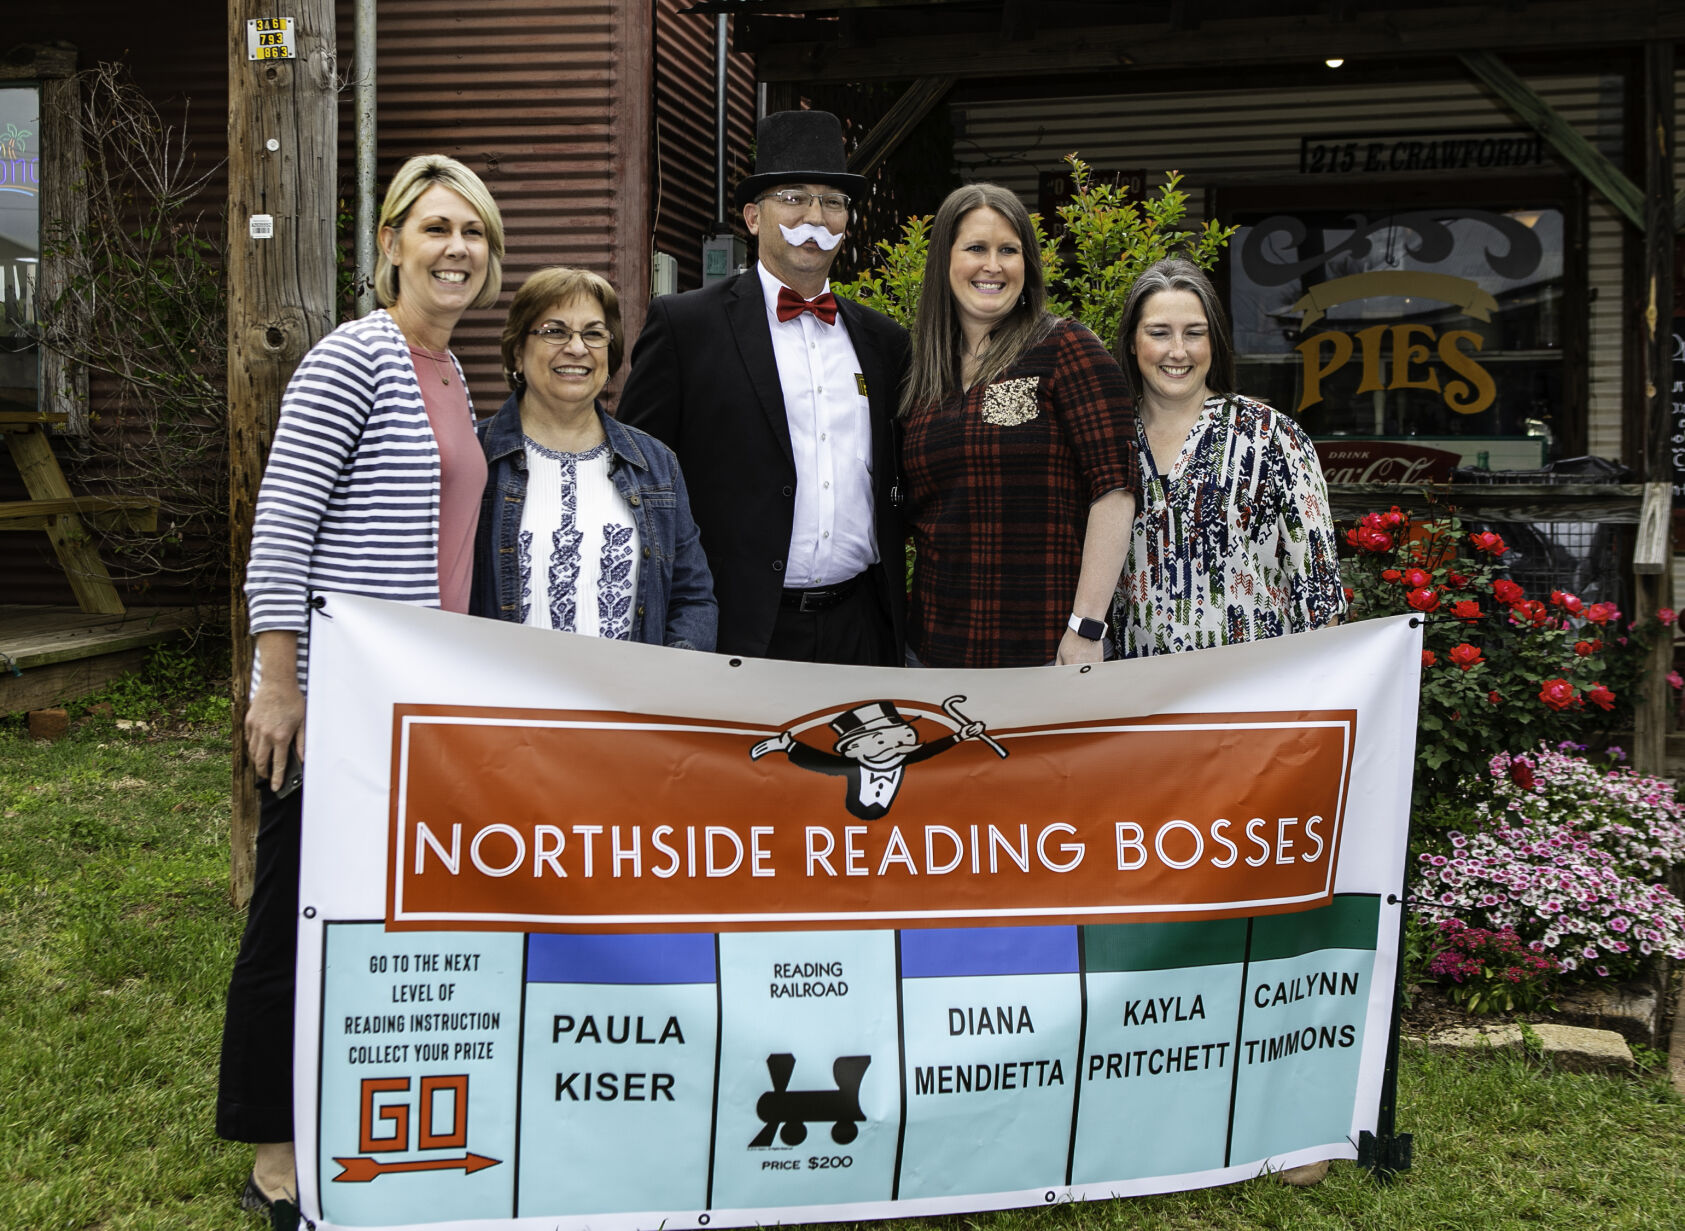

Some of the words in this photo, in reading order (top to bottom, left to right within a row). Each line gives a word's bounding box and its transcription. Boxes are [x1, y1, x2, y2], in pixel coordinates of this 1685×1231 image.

[257, 19, 279, 30] 346
[260, 33, 283, 45] 793
[265, 46, 288, 58] 863
[1309, 143, 1357, 173] 215
[1295, 324, 1496, 414] PIES
[1328, 451, 1370, 459] DRINK
[414, 822, 776, 878] NORTHSIDE
[805, 823, 1086, 876] READING
[1115, 815, 1324, 870] BOSSES
[369, 955, 388, 974] GO
[392, 955, 409, 973] TO
[414, 954, 440, 972] THE
[444, 954, 481, 972] NEXT
[774, 962, 843, 978] READING
[391, 984, 434, 1003] LEVEL
[438, 983, 456, 1001] OF
[770, 981, 849, 998] RAILROAD
[1254, 971, 1359, 1009] CAILYNN
[344, 1015, 405, 1035] READING
[410, 1012, 501, 1032] INSTRUCTION
[948, 1005, 1035, 1036] DIANA
[1123, 994, 1206, 1027] KAYLA
[552, 1015, 685, 1045] PAULA
[1245, 1024, 1356, 1065] TIMMONS
[349, 1044, 410, 1064] COLLECT
[414, 1043, 449, 1062] YOUR
[454, 1042, 494, 1060] PRIZE
[1088, 1042, 1231, 1080] PRITCHETT
[555, 1072, 676, 1101] KISER
[914, 1059, 1064, 1095] MENDIETTA
[358, 1073, 470, 1155] GO
[761, 1160, 801, 1170] PRICE
[808, 1155, 853, 1170] $200
